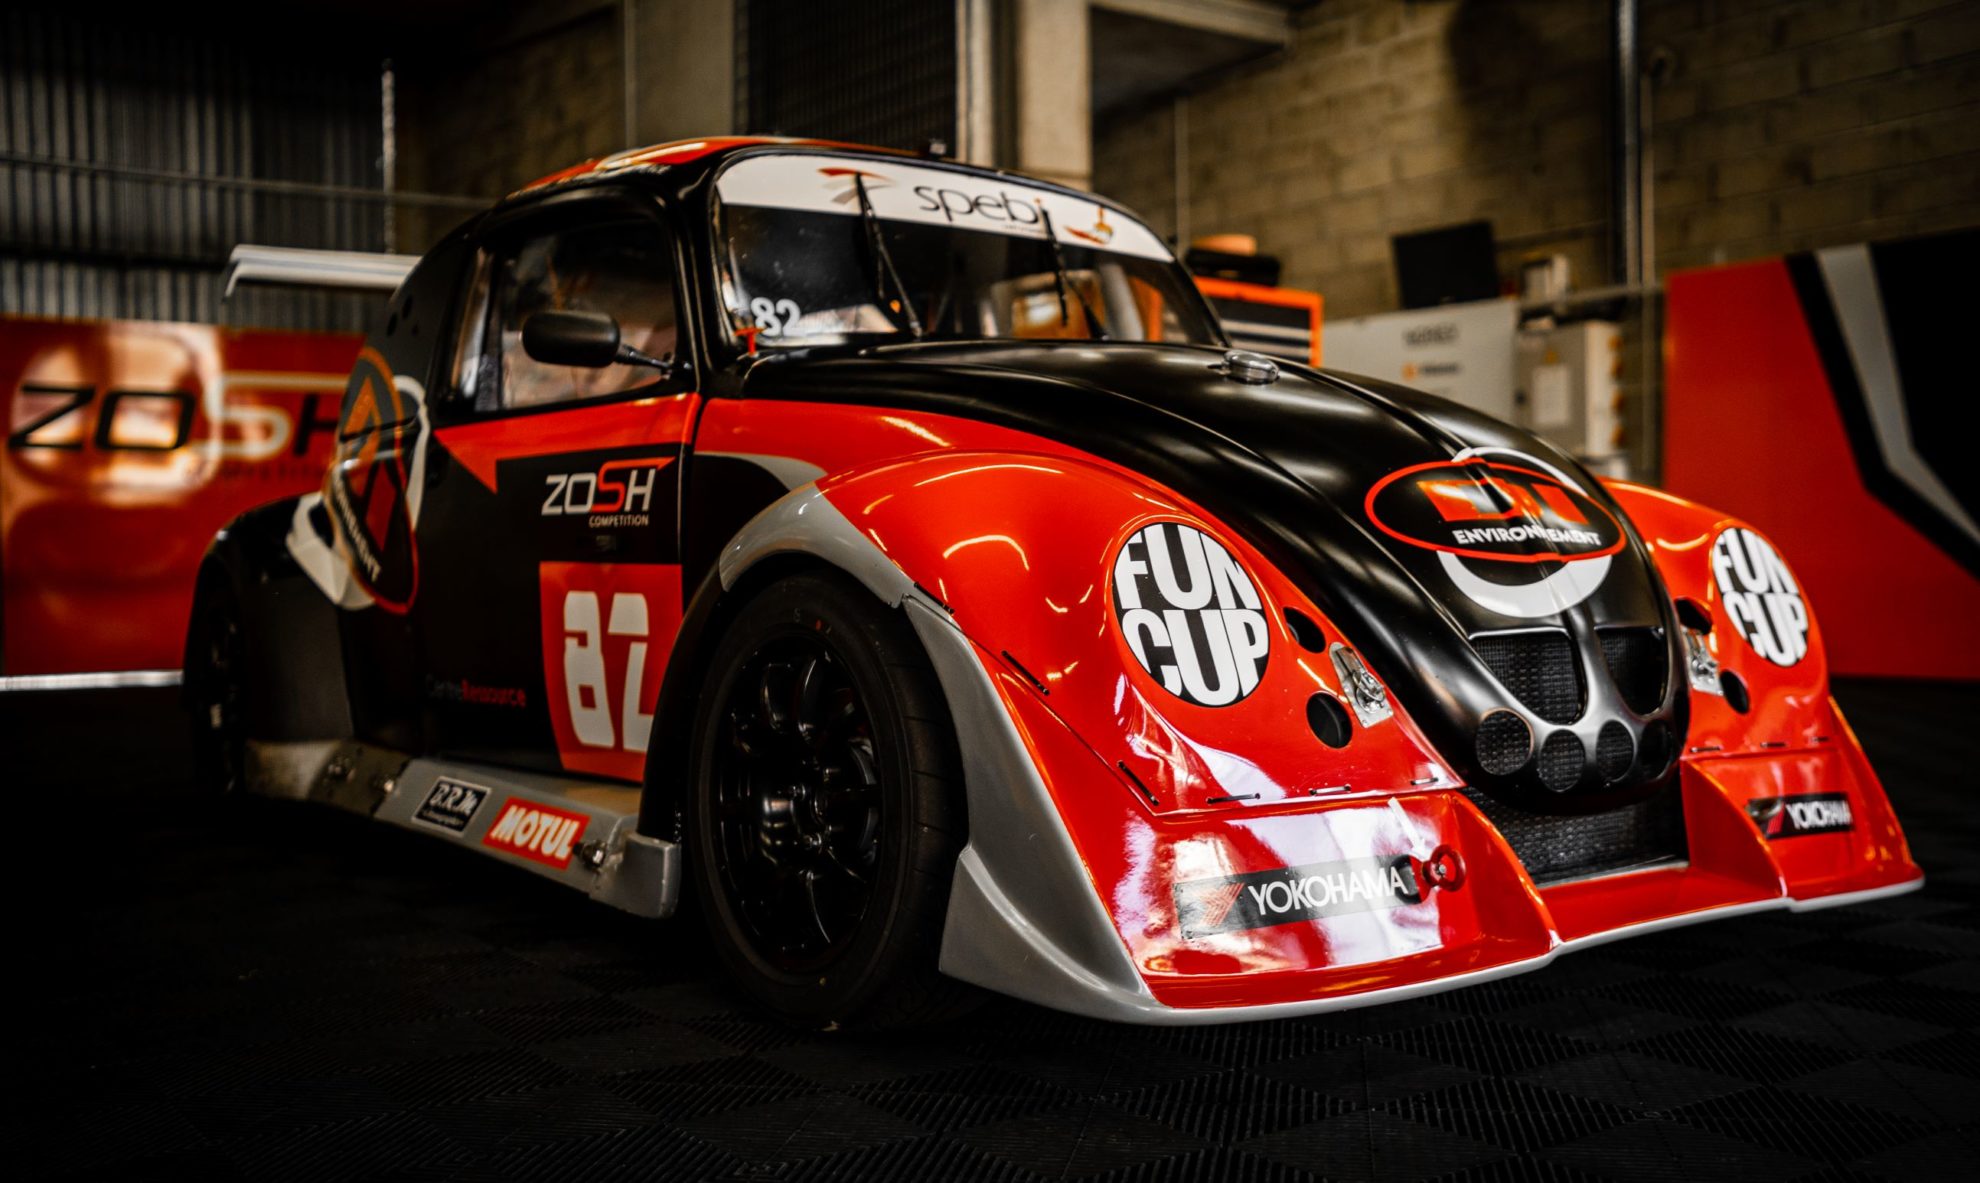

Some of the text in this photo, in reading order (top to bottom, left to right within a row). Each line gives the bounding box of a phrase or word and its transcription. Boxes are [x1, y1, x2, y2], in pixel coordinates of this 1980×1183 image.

[751, 296, 807, 338] 82
[541, 456, 676, 517] ZOSH
[588, 514, 650, 529] COMPETITION
[1114, 523, 1263, 610] FUN
[1712, 527, 1800, 595] FUN
[1122, 608, 1269, 706] CUP
[1722, 590, 1809, 668] CUP
[563, 590, 655, 754] 82
[489, 804, 580, 861] MOTUL
[1248, 866, 1409, 916] YOKOHAMA
